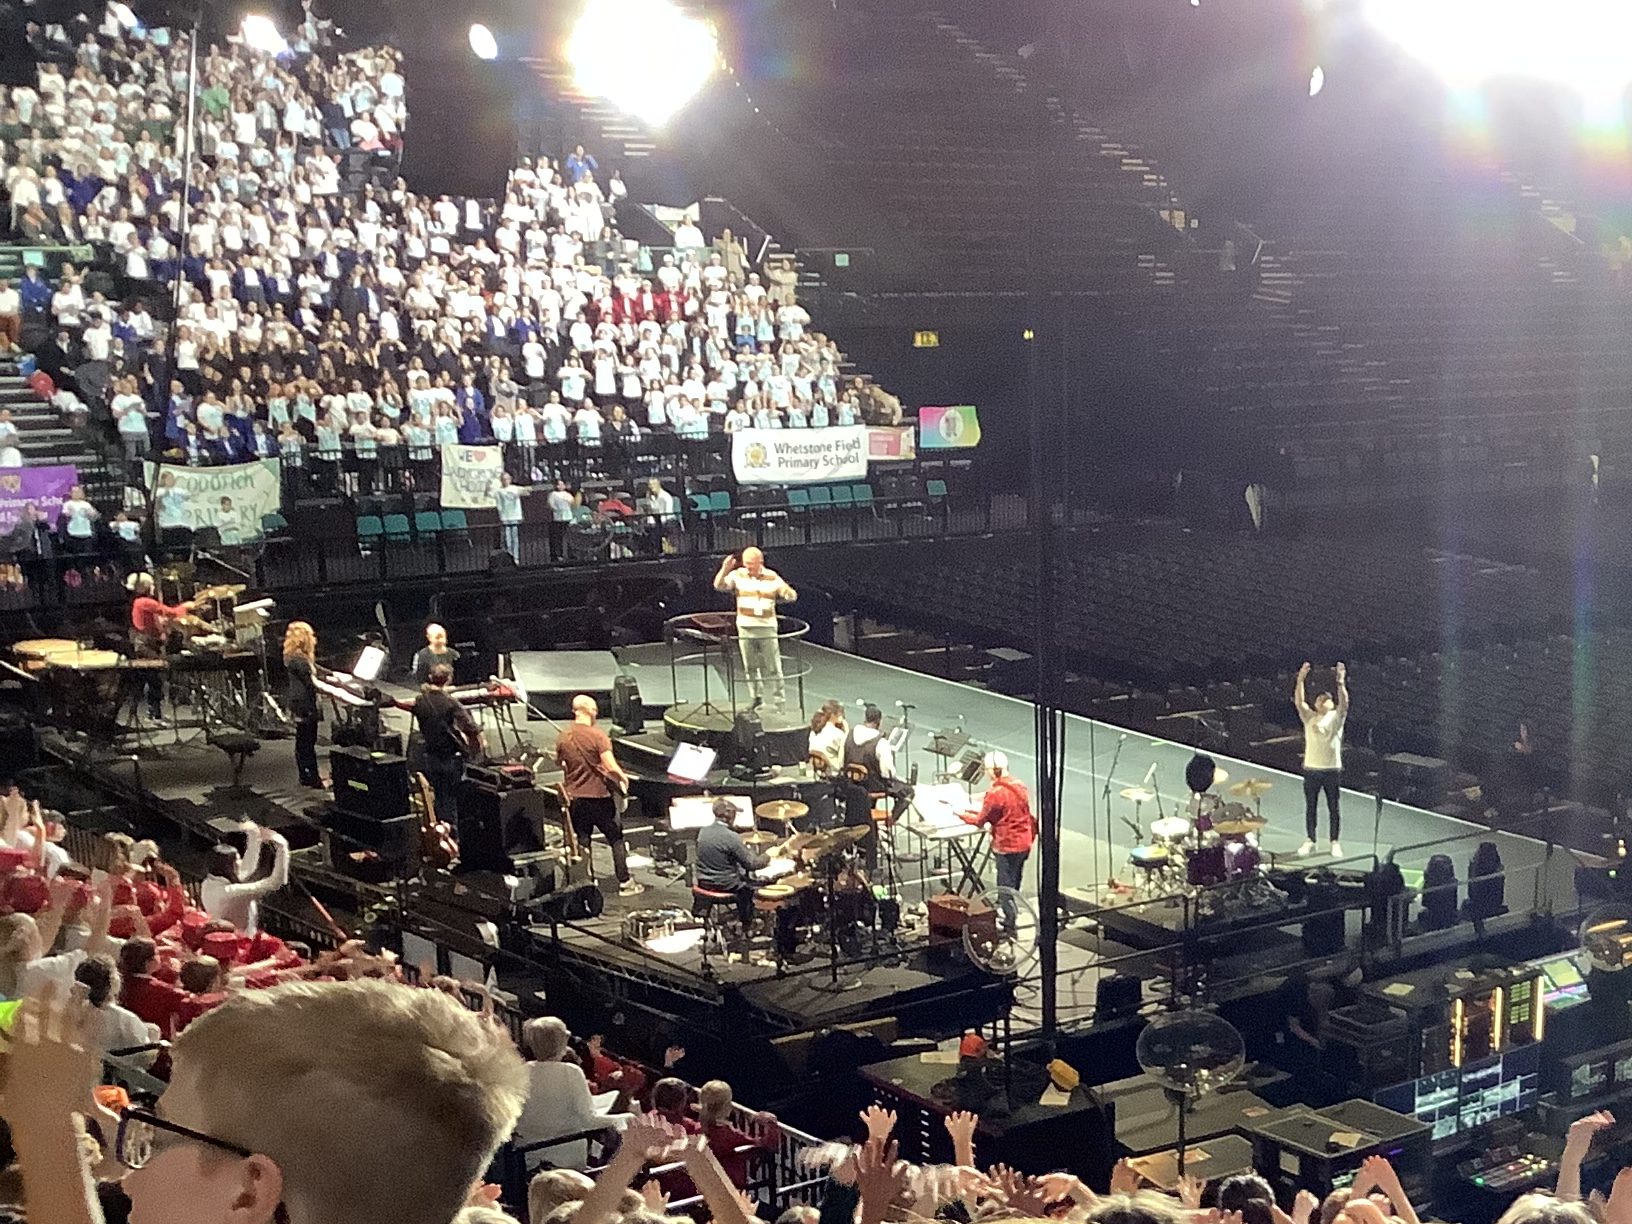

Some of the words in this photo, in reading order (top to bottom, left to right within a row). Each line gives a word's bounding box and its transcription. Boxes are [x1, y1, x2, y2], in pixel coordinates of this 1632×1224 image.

[774, 442, 832, 454] Whetstone
[835, 437, 861, 451] Field
[778, 456, 820, 469] Primary
[822, 453, 860, 467] School
